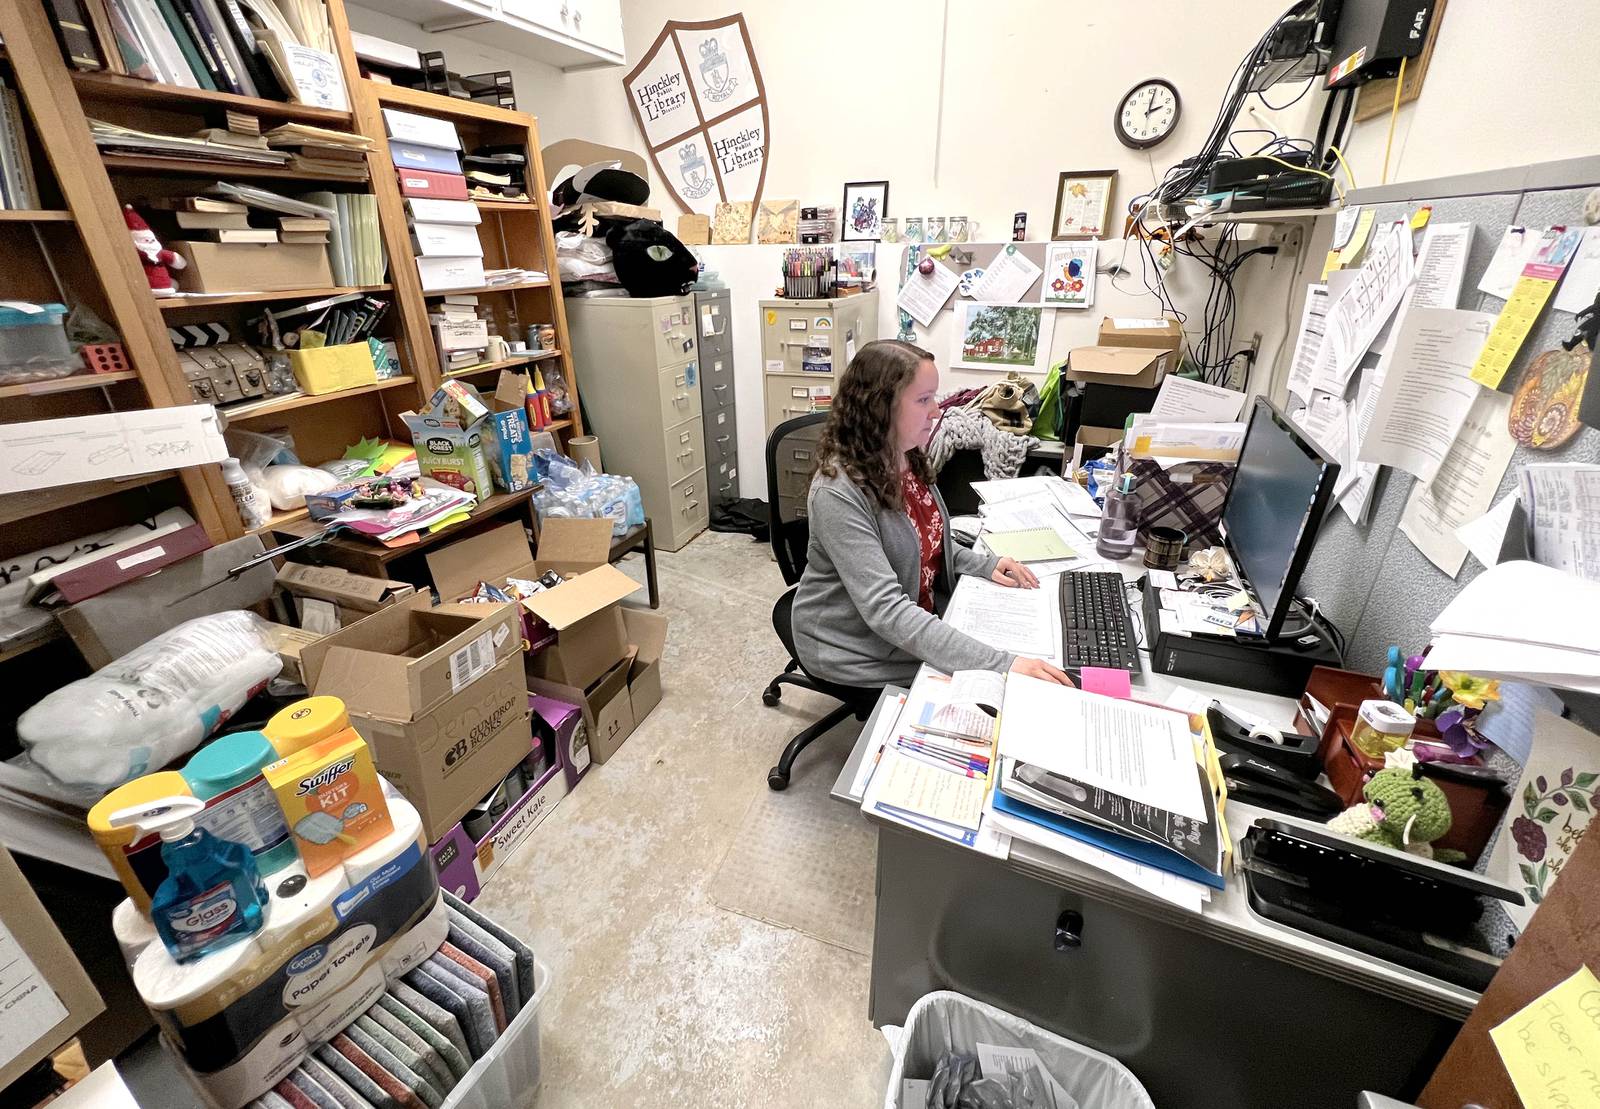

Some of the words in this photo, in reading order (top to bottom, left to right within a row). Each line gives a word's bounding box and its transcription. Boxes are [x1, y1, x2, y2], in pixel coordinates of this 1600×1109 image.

[637, 72, 680, 106] Hinckley
[645, 91, 686, 122] Library
[713, 128, 760, 158] Hinckley
[721, 145, 765, 174] Library
[506, 413, 518, 444] TREATS
[423, 457, 441, 465] JUICY
[470, 696, 516, 739] GUMDROP
[470, 720, 501, 748] BOOKS
[295, 758, 355, 796] Swiffer
[320, 786, 348, 809] KIT
[497, 815, 526, 850] Sweet
[526, 795, 546, 818] Kale
[186, 902, 229, 927] Glass
[291, 949, 322, 971] Great
[291, 969, 331, 1000] Paper
[331, 934, 371, 969] Towels
[4, 984, 39, 1011] CHINA
[1518, 1020, 1536, 1055] be
[1540, 999, 1583, 1057] Floor
